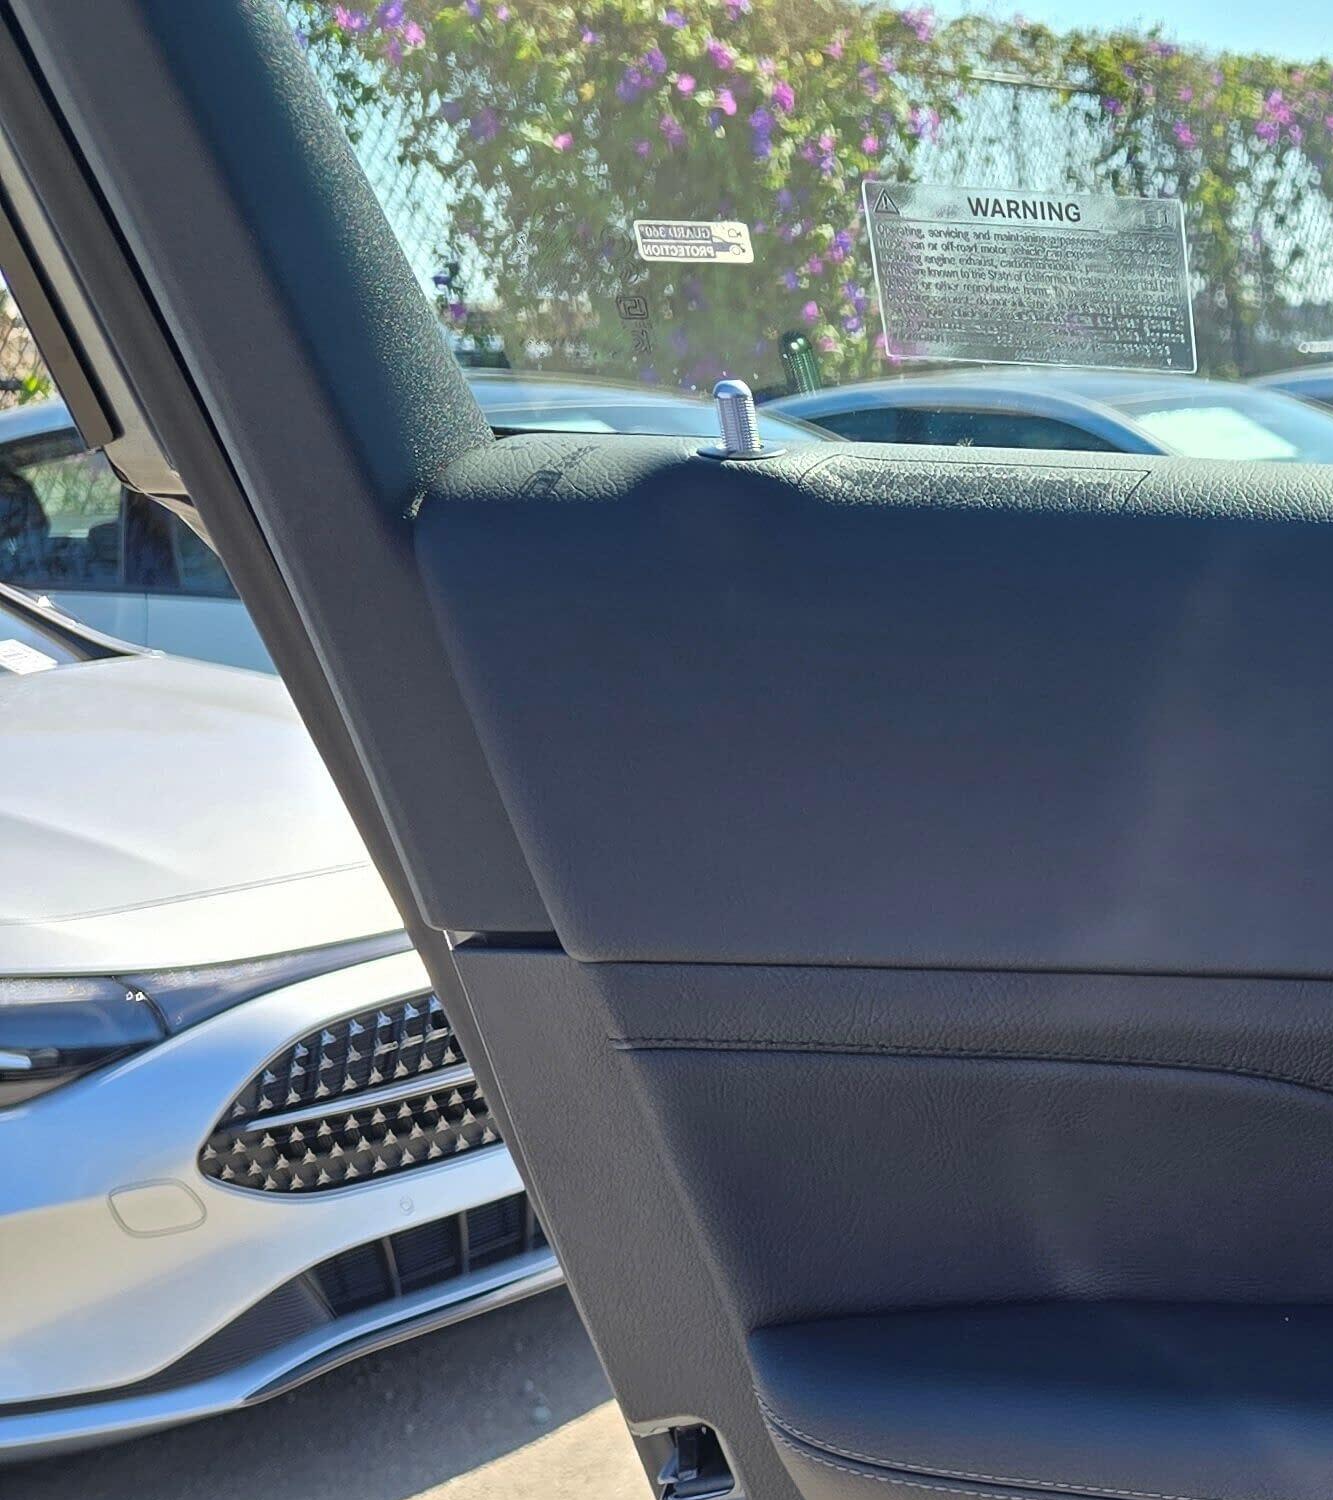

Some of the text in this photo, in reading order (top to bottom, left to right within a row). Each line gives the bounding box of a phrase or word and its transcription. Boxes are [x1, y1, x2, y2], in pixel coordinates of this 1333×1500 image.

[967, 196, 1081, 223] WARNING
[876, 223, 924, 238] Operating,
[927, 226, 969, 241] servicing
[972, 229, 989, 240] and
[993, 231, 1046, 246] maintaining
[910, 241, 924, 249] van
[940, 241, 977, 252] off-road
[980, 244, 1007, 254] motor
[924, 252, 955, 267] engine
[958, 255, 997, 268] exhaust,
[999, 257, 1032, 269] carbon
[927, 267, 959, 278] known
[960, 269, 970, 278] to
[971, 269, 986, 279] the
[987, 269, 1011, 280] State
[1013, 271, 1022, 281] of
